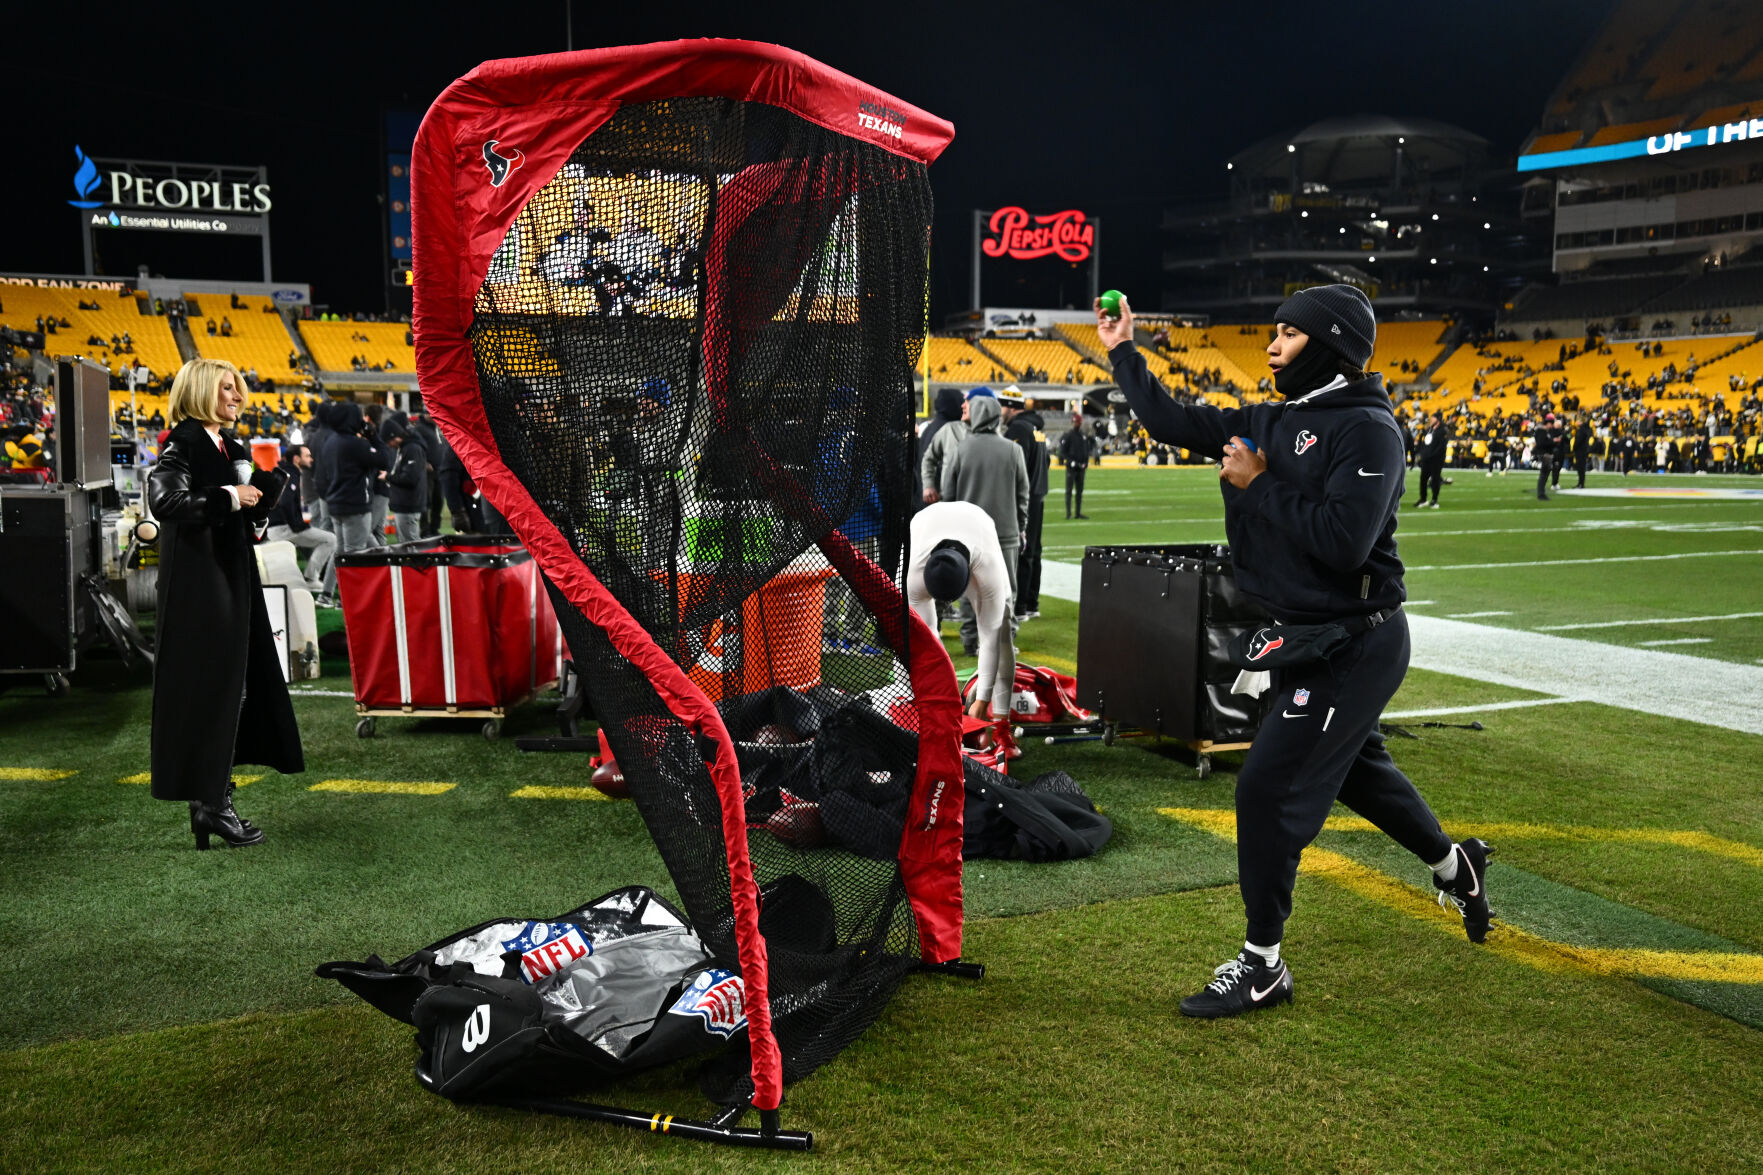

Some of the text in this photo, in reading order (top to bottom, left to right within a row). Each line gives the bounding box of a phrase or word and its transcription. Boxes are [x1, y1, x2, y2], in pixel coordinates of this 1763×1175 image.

[858, 112, 902, 139] TEXANS
[859, 100, 907, 125] HOUSTON
[110, 171, 272, 213] PEOPLES
[91, 213, 108, 225] An
[120, 215, 169, 228] Essential
[171, 218, 211, 231] Utilities
[924, 781, 945, 831] TEXANS
[521, 936, 587, 983] NFL
